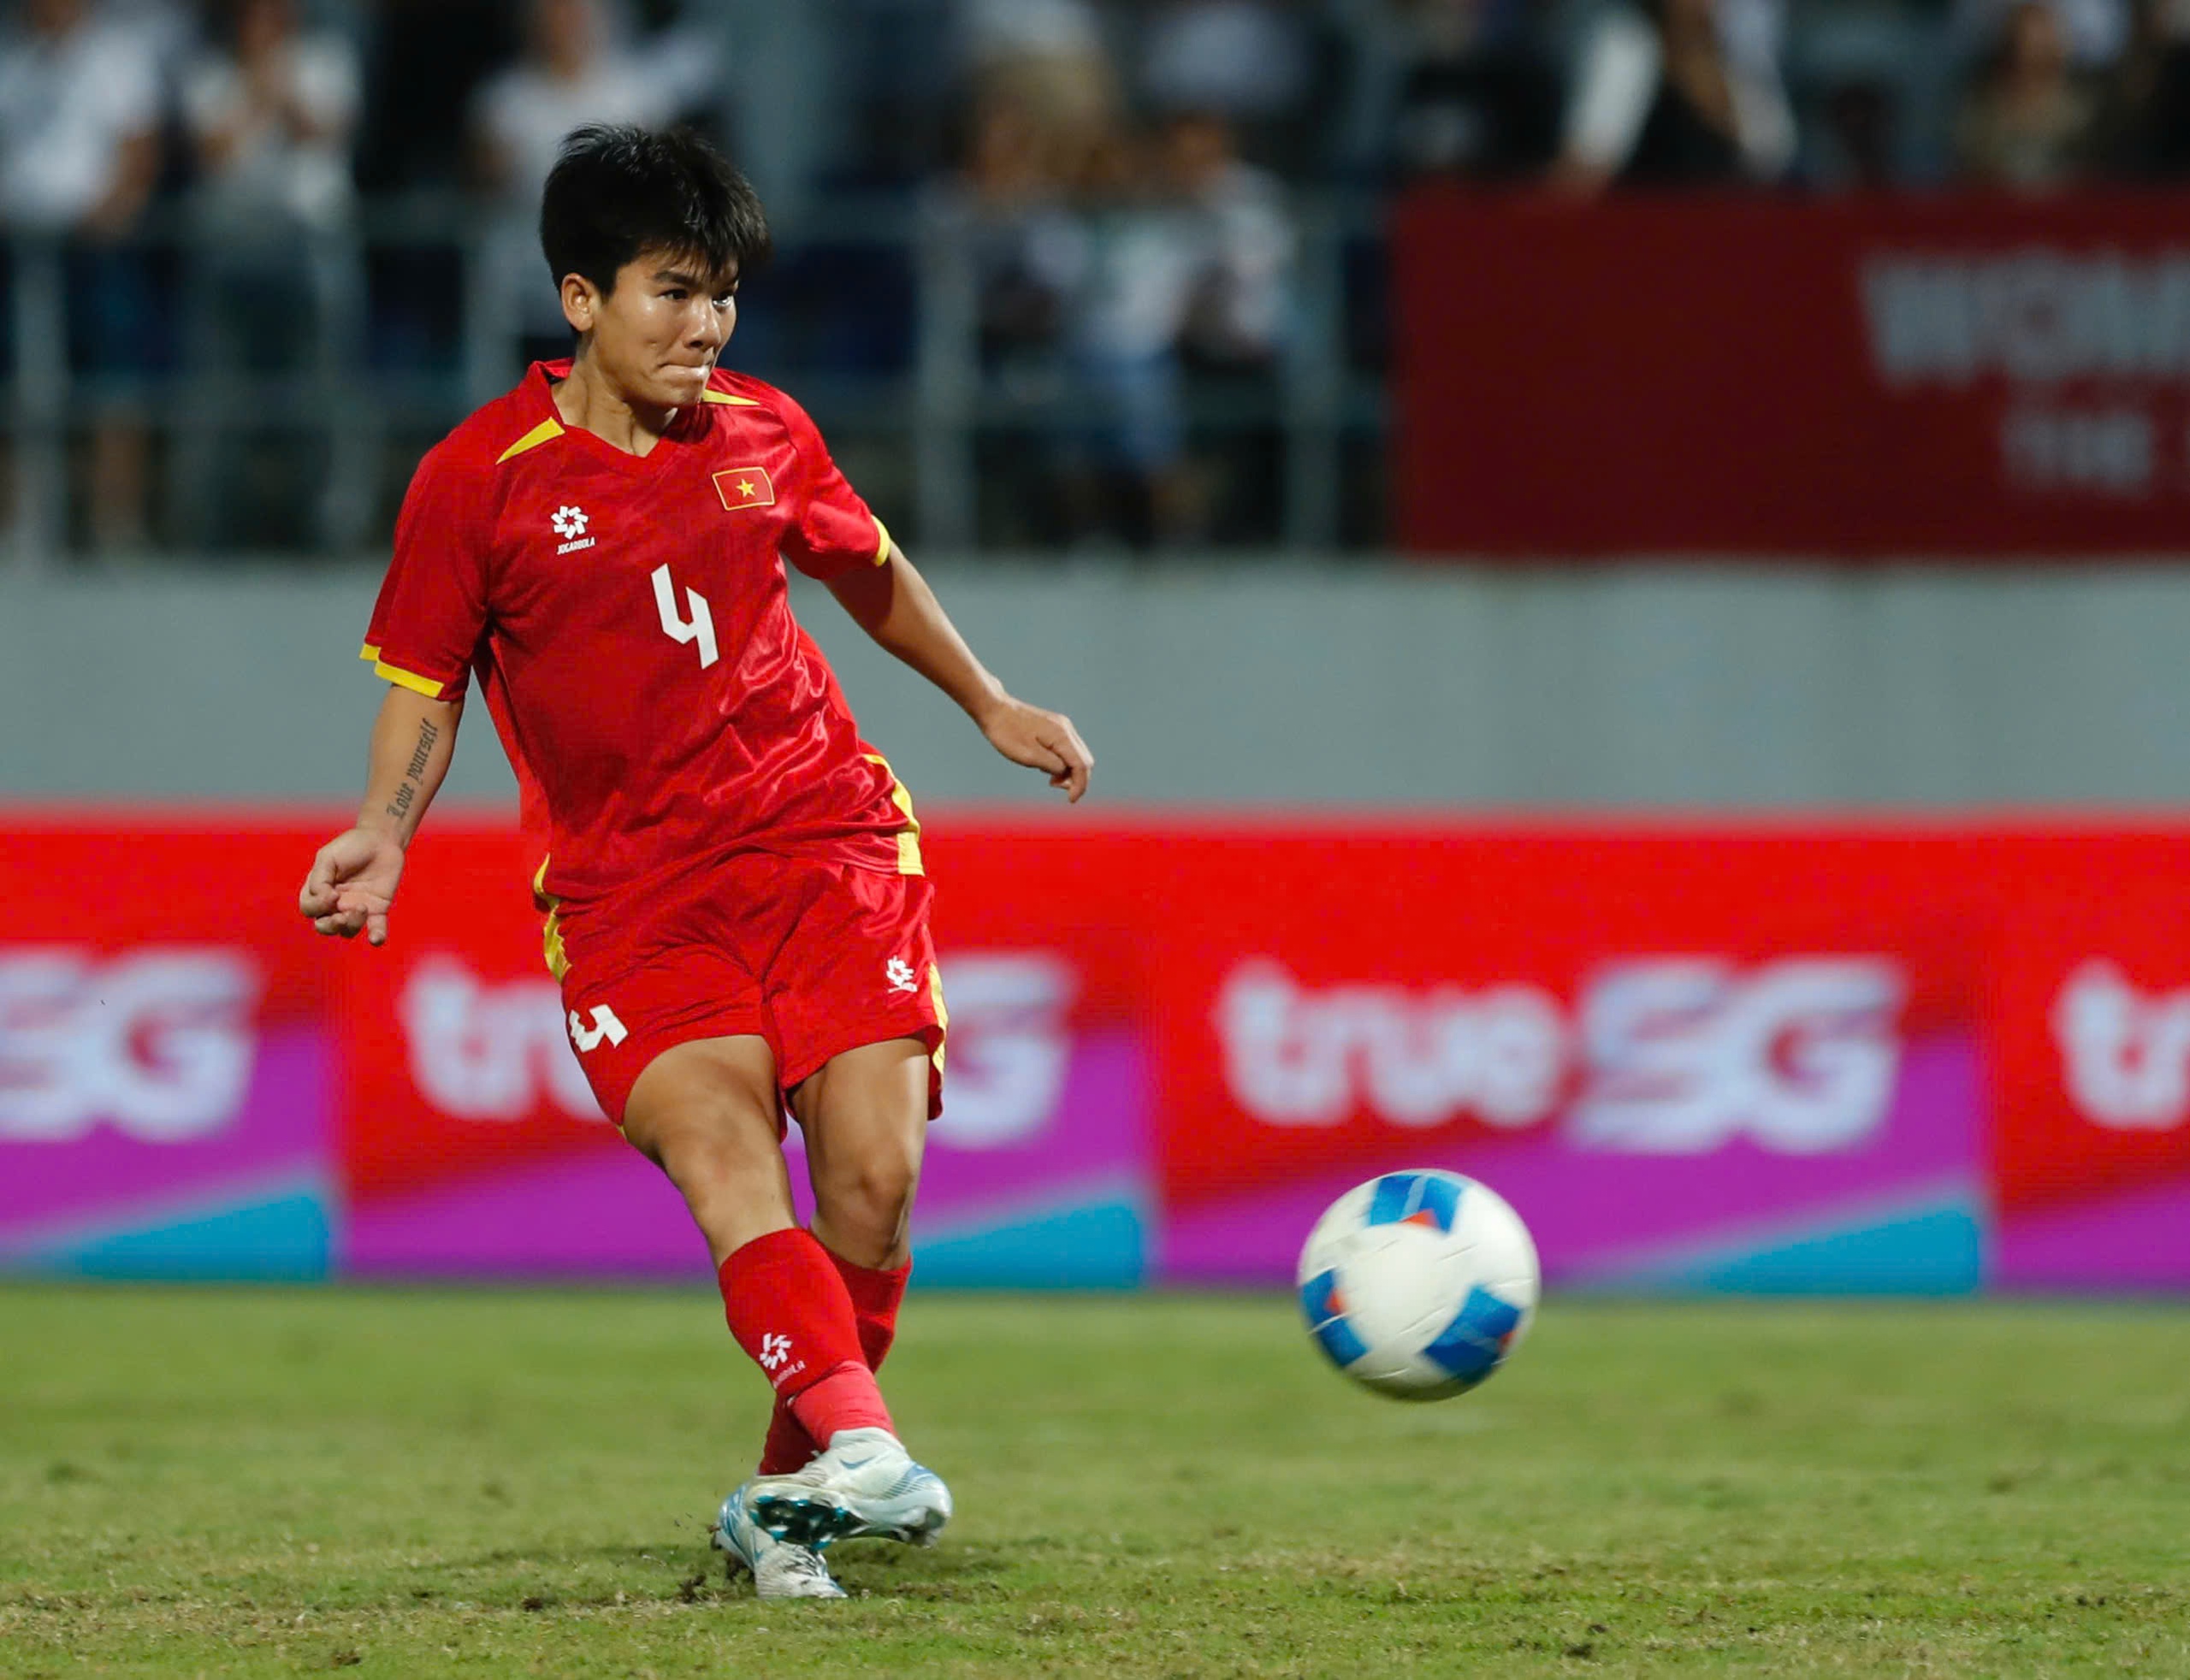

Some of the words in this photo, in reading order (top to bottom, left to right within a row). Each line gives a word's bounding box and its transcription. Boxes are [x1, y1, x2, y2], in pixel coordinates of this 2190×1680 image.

[650, 563, 719, 670] 4
[568, 1003, 629, 1053] 4
[1216, 956, 1562, 1125] true
